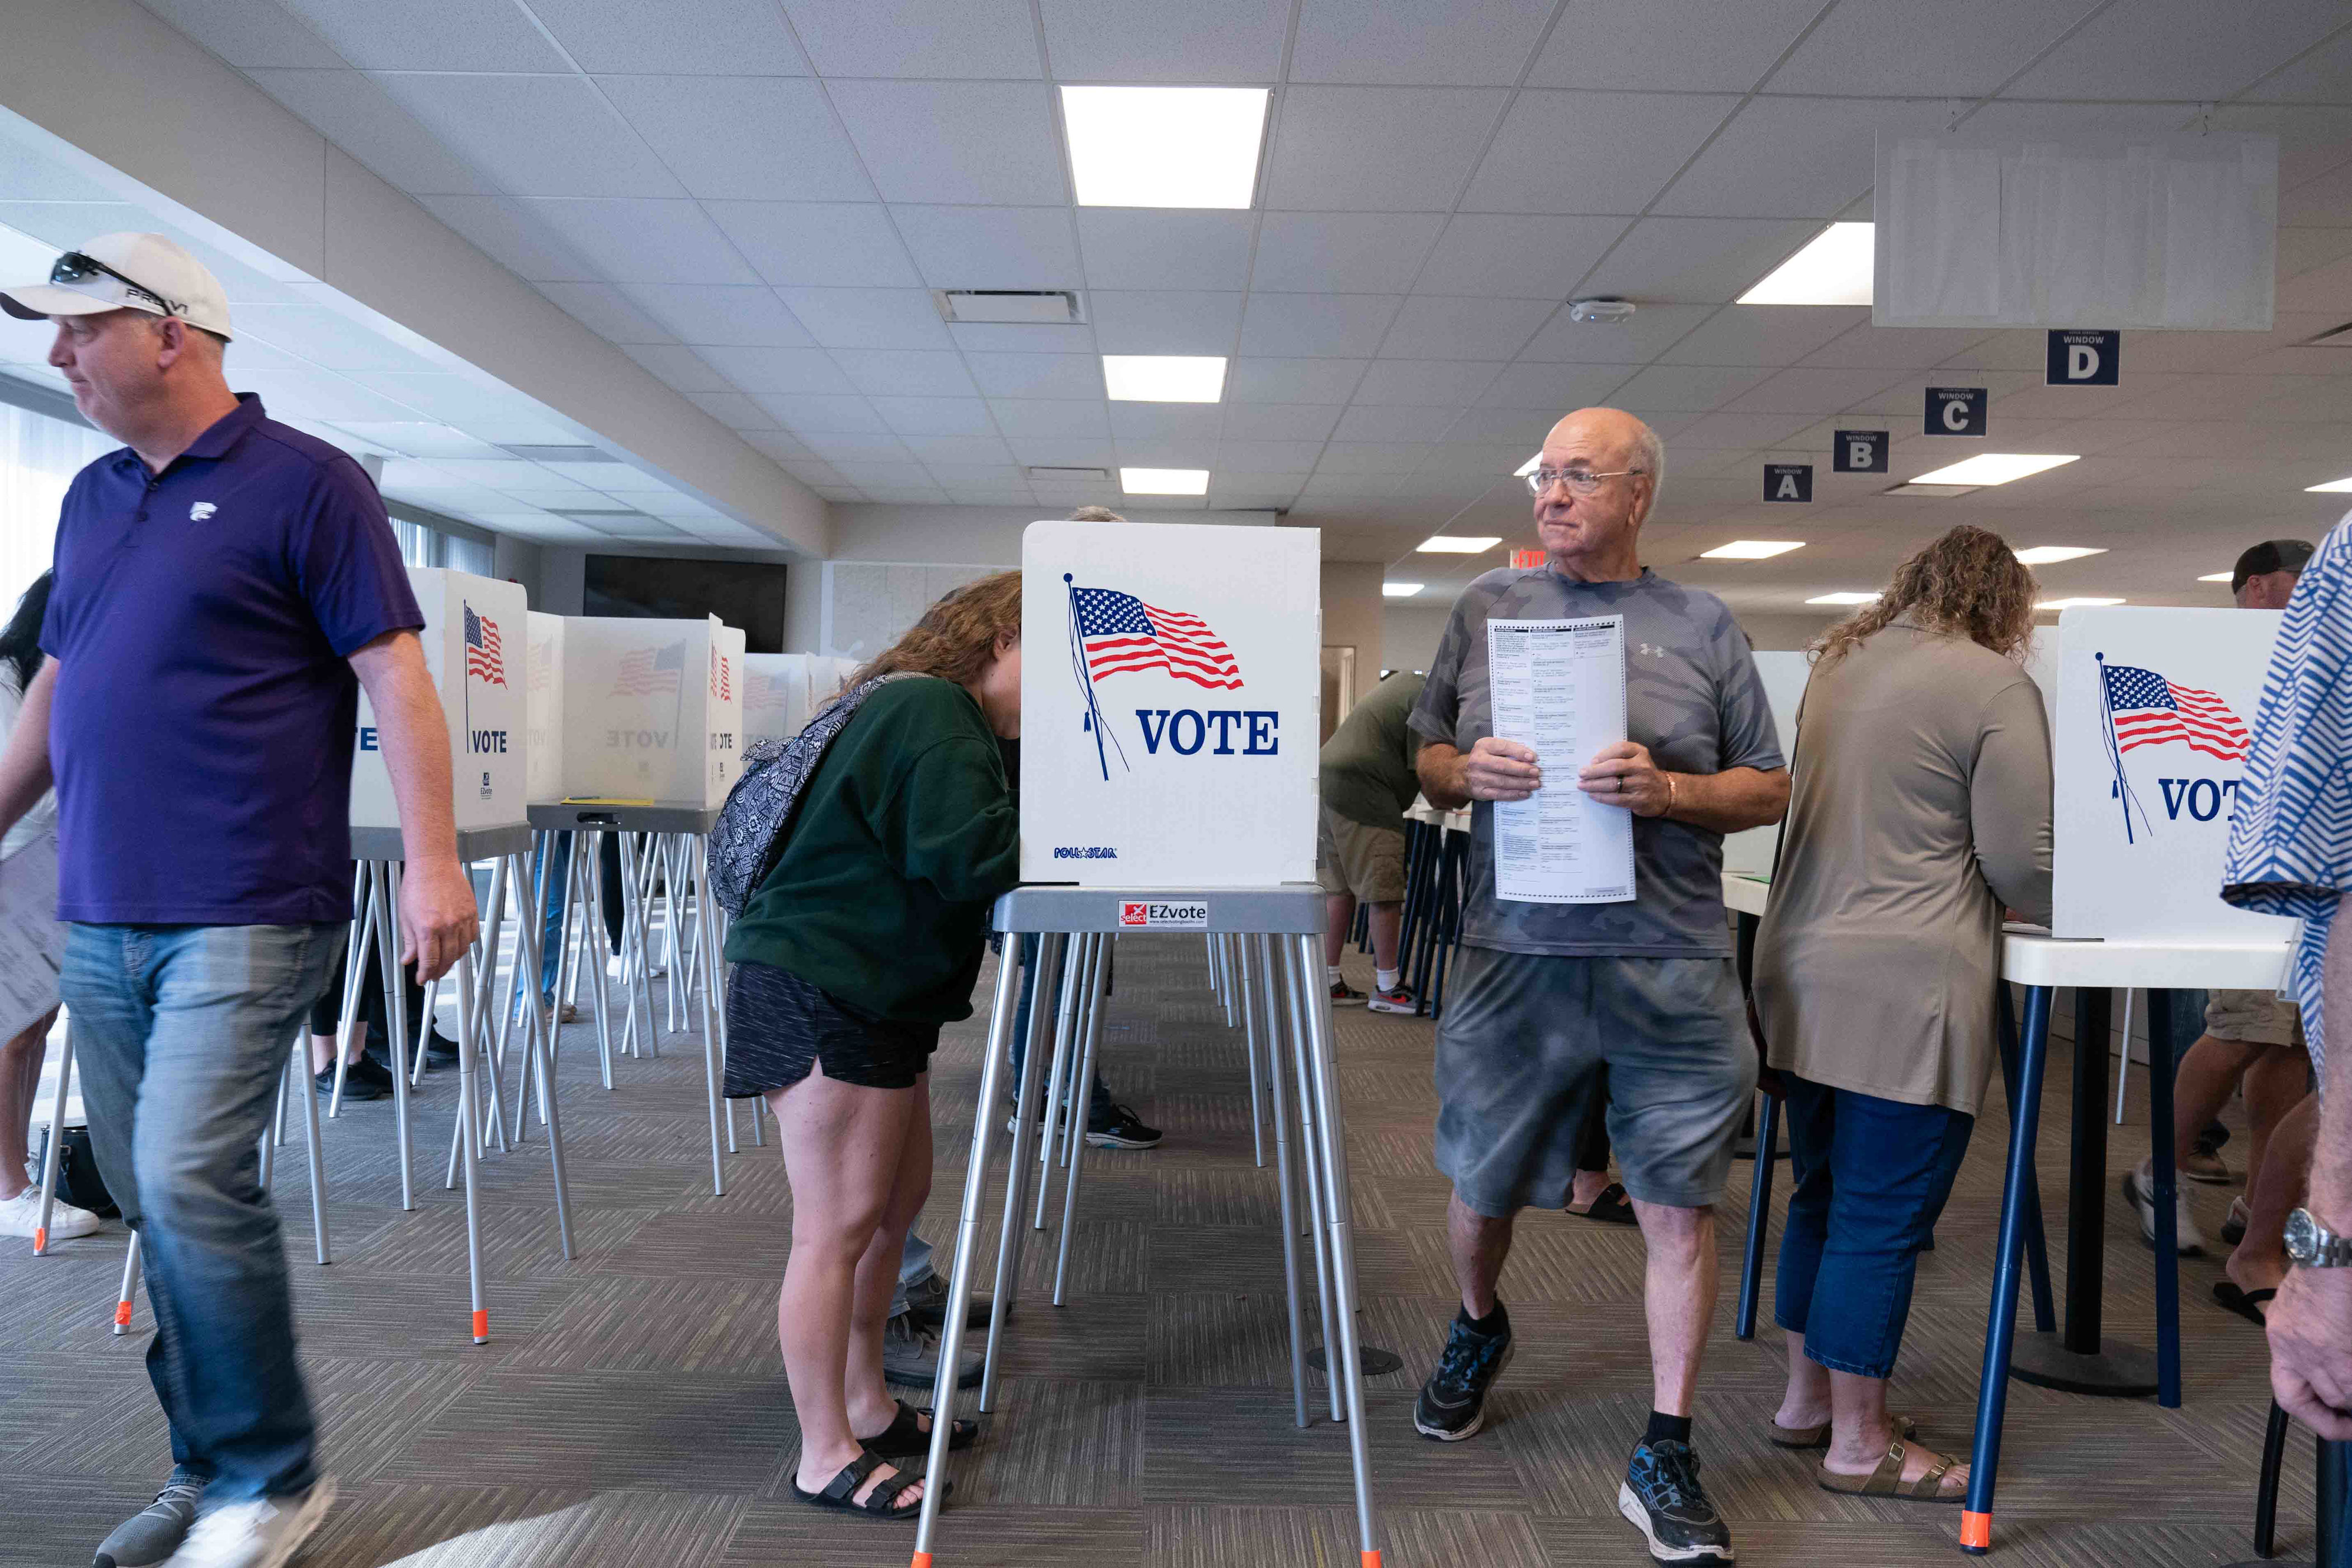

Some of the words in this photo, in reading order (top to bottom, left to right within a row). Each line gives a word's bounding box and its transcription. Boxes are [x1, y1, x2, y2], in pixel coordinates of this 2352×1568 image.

[2068, 345, 2099, 379] D
[1943, 400, 1969, 431] C
[1850, 442, 1872, 467] B
[1776, 475, 1798, 498] A
[1519, 550, 1546, 569] EXIT
[473, 730, 507, 753] VOTE
[1136, 710, 1278, 755] VOTE
[2159, 778, 2241, 821] VOT
[1121, 913, 1146, 922] select
[1150, 905, 1206, 918] EZvote
